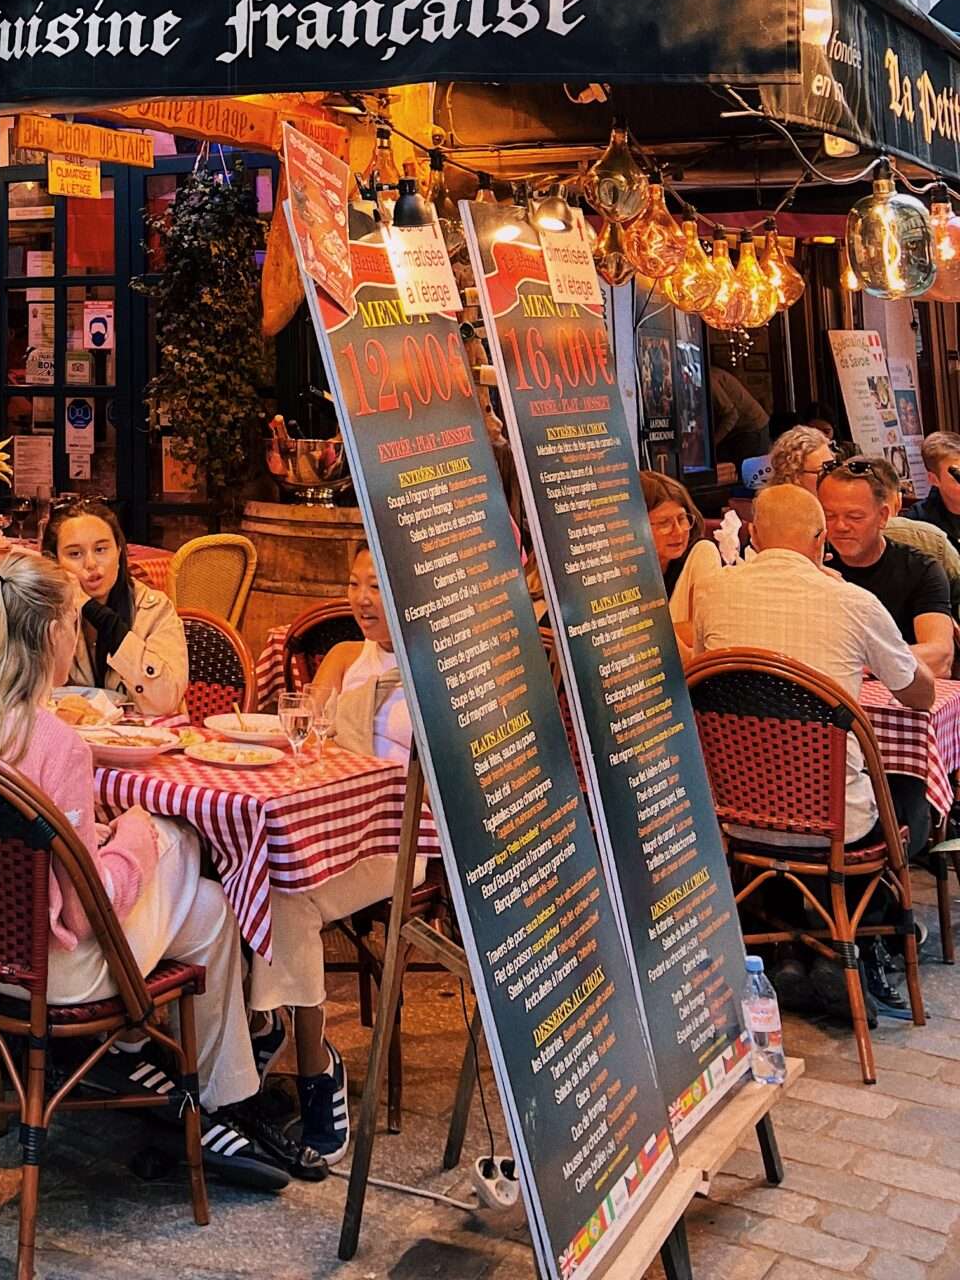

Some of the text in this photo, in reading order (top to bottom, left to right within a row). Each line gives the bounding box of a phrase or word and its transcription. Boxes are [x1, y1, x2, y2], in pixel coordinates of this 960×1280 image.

[829, 30, 861, 69] fondée
[812, 74, 831, 98] en
[885, 47, 915, 123] La
[57, 123, 91, 153] ROOM
[100, 132, 152, 162] UPSTAIRS
[342, 332, 473, 420] 12,00€
[504, 326, 615, 398] 16,00€
[471, 712, 531, 756] PLATS AU CHOIX
[533, 998, 574, 1046] DESSERTS
[571, 987, 583, 1009] AU
[582, 967, 604, 998] CHOIX
